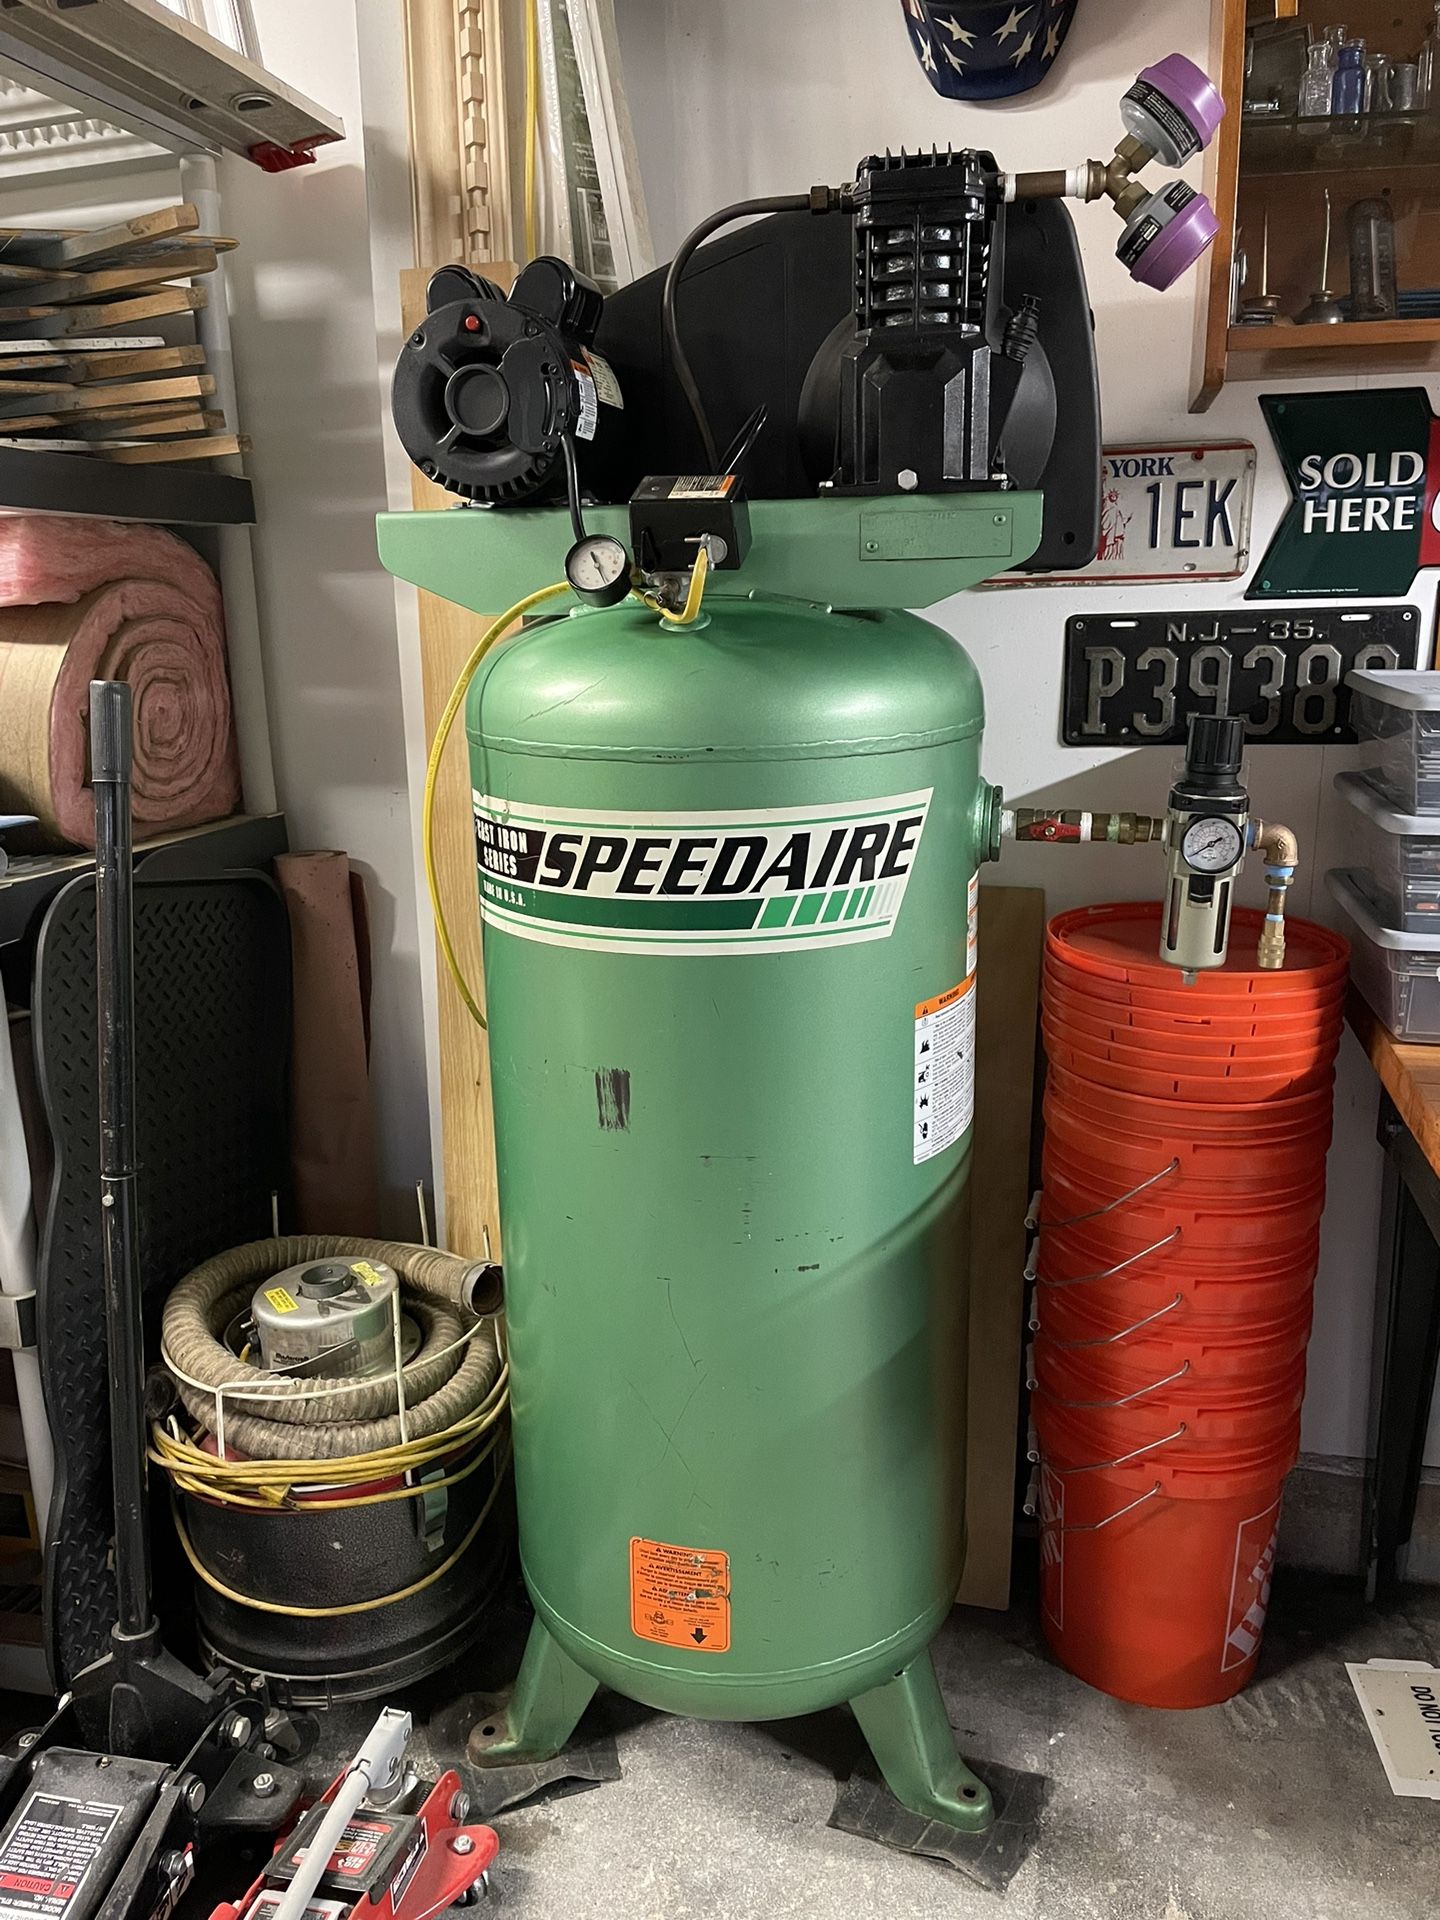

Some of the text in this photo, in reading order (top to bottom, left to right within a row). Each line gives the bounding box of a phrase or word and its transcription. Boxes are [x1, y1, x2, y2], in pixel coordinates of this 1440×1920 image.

[1109, 457, 1174, 479] YORK
[1300, 451, 1424, 491] SOLD
[1146, 479, 1237, 549] 1EK
[1303, 496, 1416, 534] HERE
[1082, 644, 1399, 736] P3938
[497, 826, 528, 854] IRON
[535, 816, 923, 895] SPEEDAIRE
[484, 846, 517, 876] SERIES
[1411, 1686, 1435, 1701] DO
[13, 1878, 52, 1891] CAUTION
